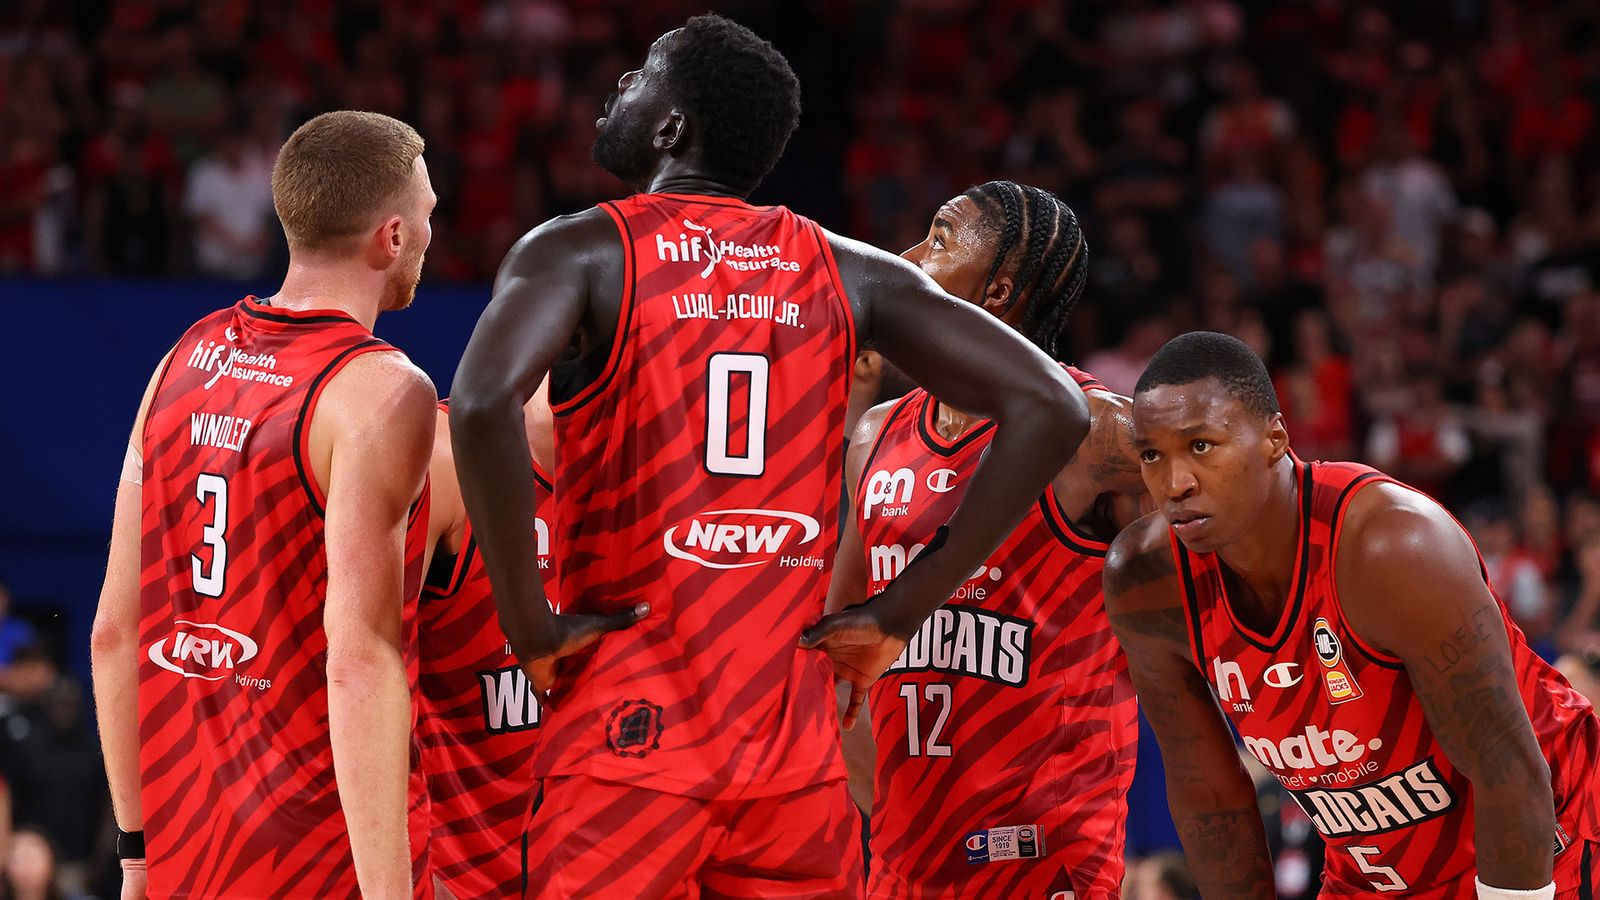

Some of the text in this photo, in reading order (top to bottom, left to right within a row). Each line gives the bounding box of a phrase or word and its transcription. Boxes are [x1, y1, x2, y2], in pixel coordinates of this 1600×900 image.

[656, 233, 702, 262] hif
[775, 301, 805, 329] JR.
[187, 340, 226, 372] hif
[231, 347, 276, 370] Health
[704, 352, 770, 477] 0
[190, 412, 252, 453] WINDLER
[882, 505, 909, 518] bank
[191, 470, 229, 600] 3
[685, 518, 792, 554] NRW
[780, 555, 824, 570] Holding
[950, 583, 987, 600] bile
[886, 609, 1029, 685] DCATS
[899, 684, 952, 757] 12
[1232, 701, 1255, 713] ank
[1243, 724, 1383, 770] mate.
[1320, 760, 1379, 785] mobile
[992, 835, 1011, 844] SINCE
[1346, 845, 1408, 892] 5
